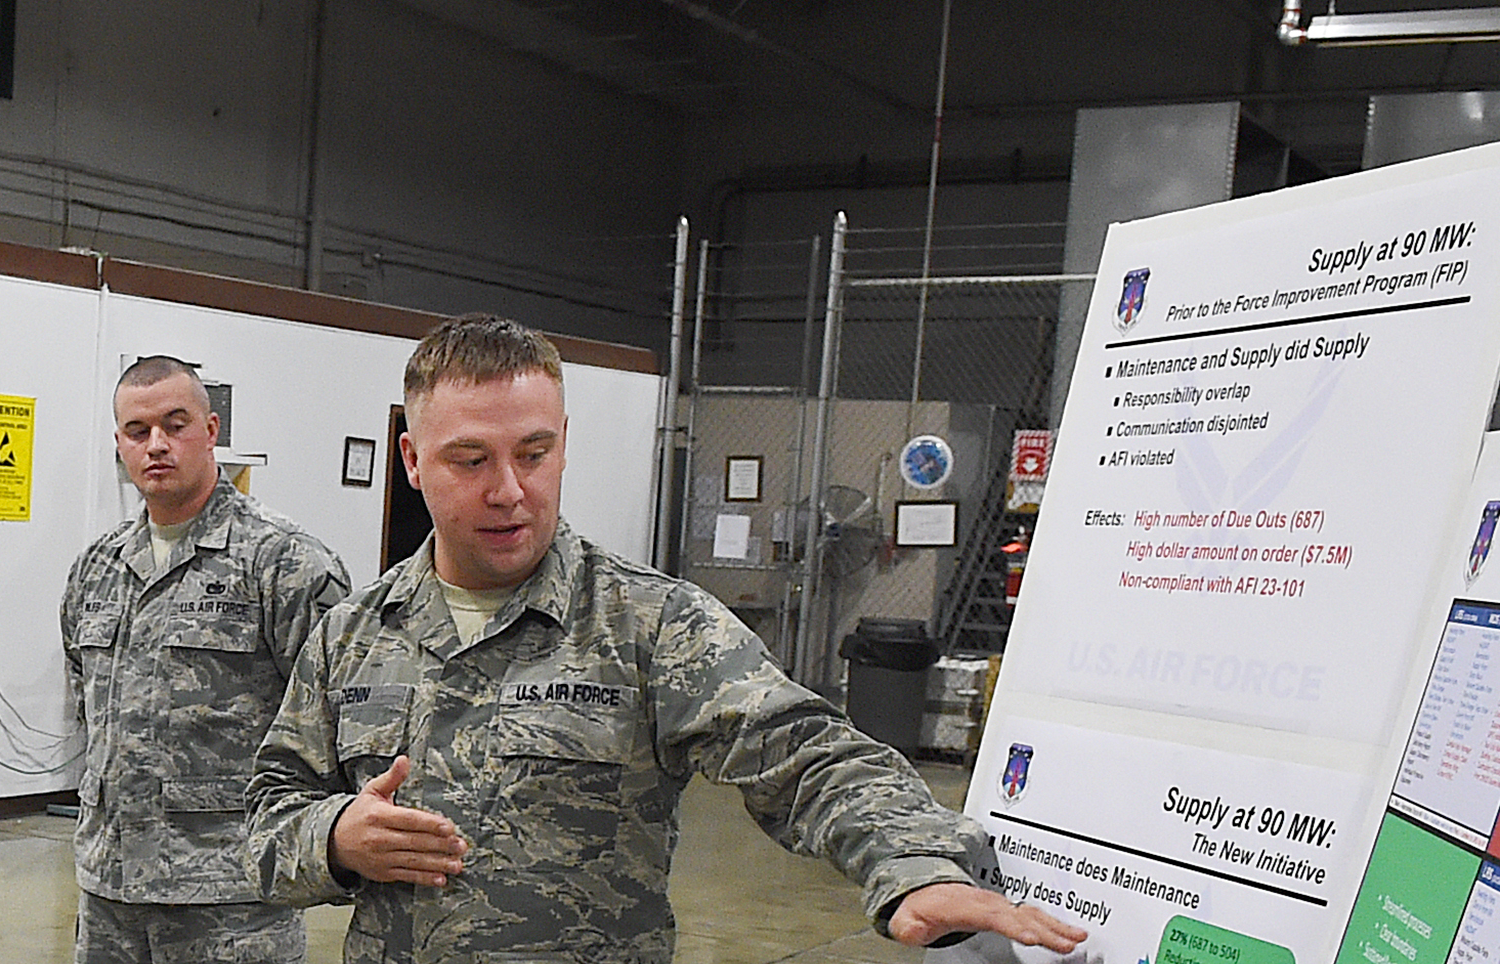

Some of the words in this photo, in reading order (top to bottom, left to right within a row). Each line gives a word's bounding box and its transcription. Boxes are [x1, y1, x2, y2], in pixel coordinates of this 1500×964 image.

[1308, 240, 1373, 275] Supply
[1376, 236, 1398, 262] at
[1401, 230, 1426, 257] 90
[1429, 221, 1476, 253] MW:
[1166, 304, 1195, 323] Prior
[1197, 302, 1210, 318] to
[1211, 297, 1231, 316] the
[1234, 292, 1269, 314] Force
[1272, 277, 1360, 312] Improvement
[1363, 268, 1428, 299] Program
[1430, 260, 1469, 290] (FIP)
[1116, 355, 1197, 379] Maintenance
[1200, 349, 1228, 371] and
[1230, 342, 1282, 370] Supply
[1285, 338, 1310, 362] did
[1313, 332, 1370, 362] Supply
[1123, 385, 1203, 410] Responsibility
[1205, 382, 1251, 402] overlap
[1116, 418, 1203, 438] Communication
[1206, 411, 1269, 437] disjointed
[1108, 451, 1128, 467] AFI
[1130, 449, 1175, 466] violated
[1085, 510, 1126, 527] Effects:
[1134, 510, 1161, 531] High
[1163, 510, 1208, 528] number
[1211, 510, 1226, 528] of
[1226, 510, 1252, 528] Due
[1255, 510, 1286, 529] Outs
[1289, 510, 1325, 534] (687)
[1126, 541, 1153, 561] High
[1155, 542, 1191, 560] dollar
[1192, 545, 1238, 562] amount
[1241, 547, 1258, 562] on
[1261, 545, 1299, 563] order
[1300, 545, 1353, 569] ($7.5M)
[1119, 571, 1204, 594] Non-compliant
[1206, 575, 1232, 594] with
[1234, 578, 1258, 596] AFI
[1260, 578, 1305, 598] 23-101
[198, 601, 214, 613] AIR
[216, 601, 250, 616] FORCE
[1126, 648, 1186, 683] AIR
[1190, 654, 1326, 702] FORCE
[516, 684, 541, 701] U.S.
[545, 684, 570, 702] AIR
[572, 684, 620, 707] FORCE
[1163, 786, 1230, 830] Supply
[1232, 805, 1255, 830] at
[1257, 808, 1284, 837] 90
[1287, 812, 1338, 849] MW:
[998, 833, 1073, 872] Maintenance
[1075, 855, 1108, 883] does
[1111, 866, 1200, 910] Maintenance
[1192, 832, 1216, 858] The
[1219, 841, 1253, 867] New
[1256, 849, 1326, 886] Initiative
[990, 866, 1032, 900] Supply
[1034, 880, 1063, 906] does
[1065, 889, 1112, 926] Supply
[1169, 929, 1188, 946] 27%
[1209, 942, 1219, 956] to
[1219, 944, 1241, 964] 504)
